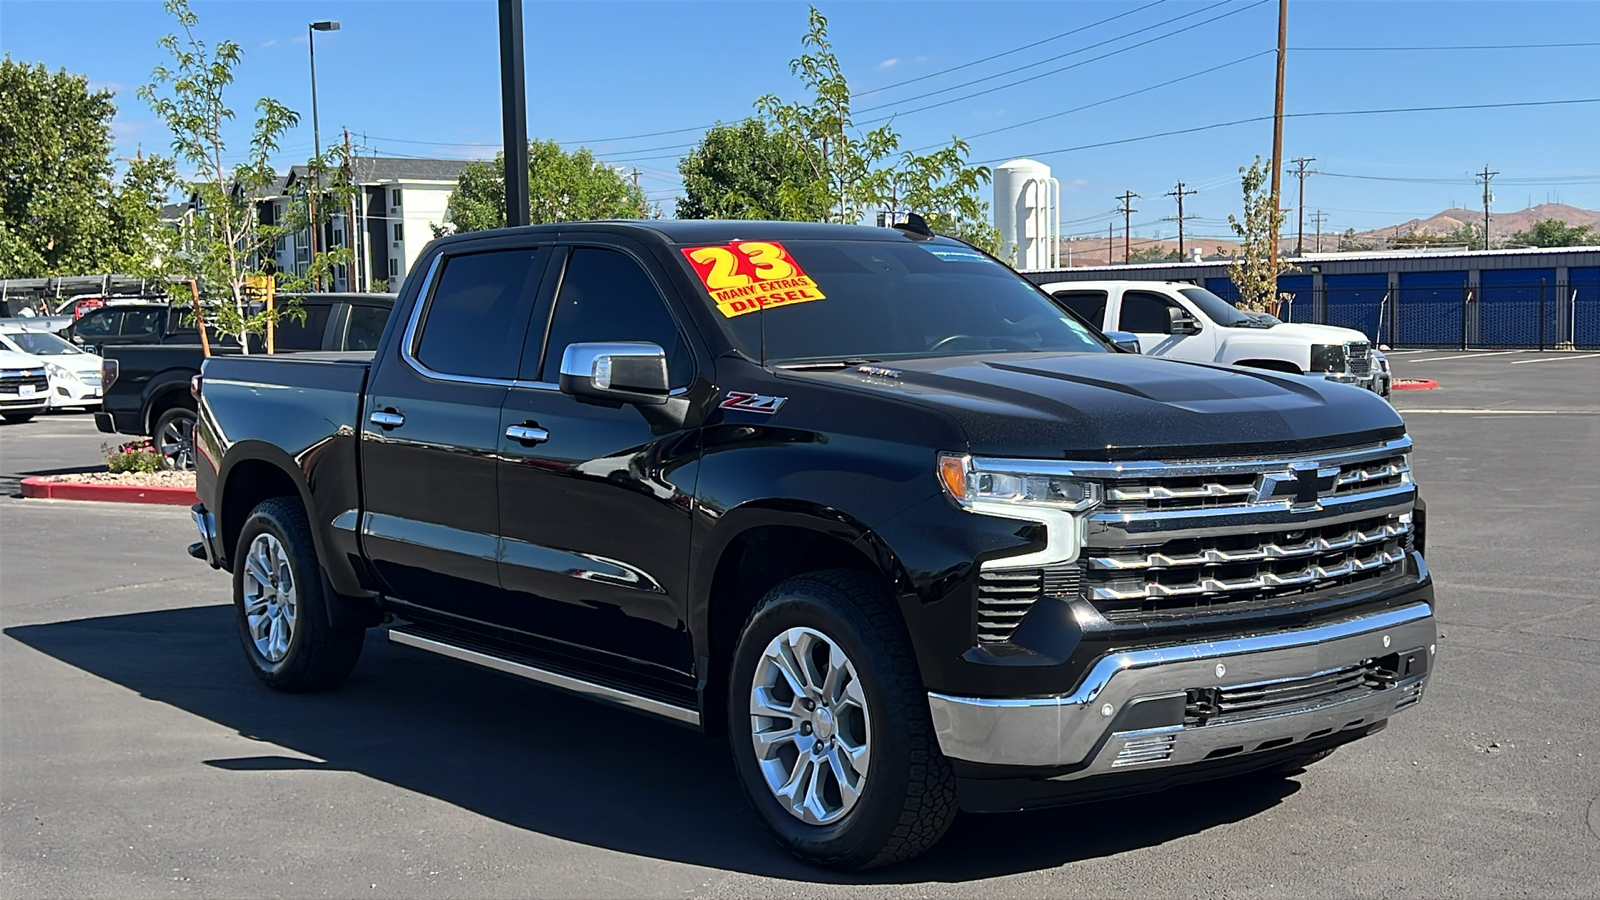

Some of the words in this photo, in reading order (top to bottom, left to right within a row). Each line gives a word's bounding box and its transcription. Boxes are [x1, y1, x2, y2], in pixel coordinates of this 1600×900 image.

[690, 242, 797, 290] 23
[716, 285, 756, 302] MANY
[760, 277, 808, 293] EXTRAS
[730, 289, 815, 313] DIESEL
[719, 391, 788, 415] Z71
